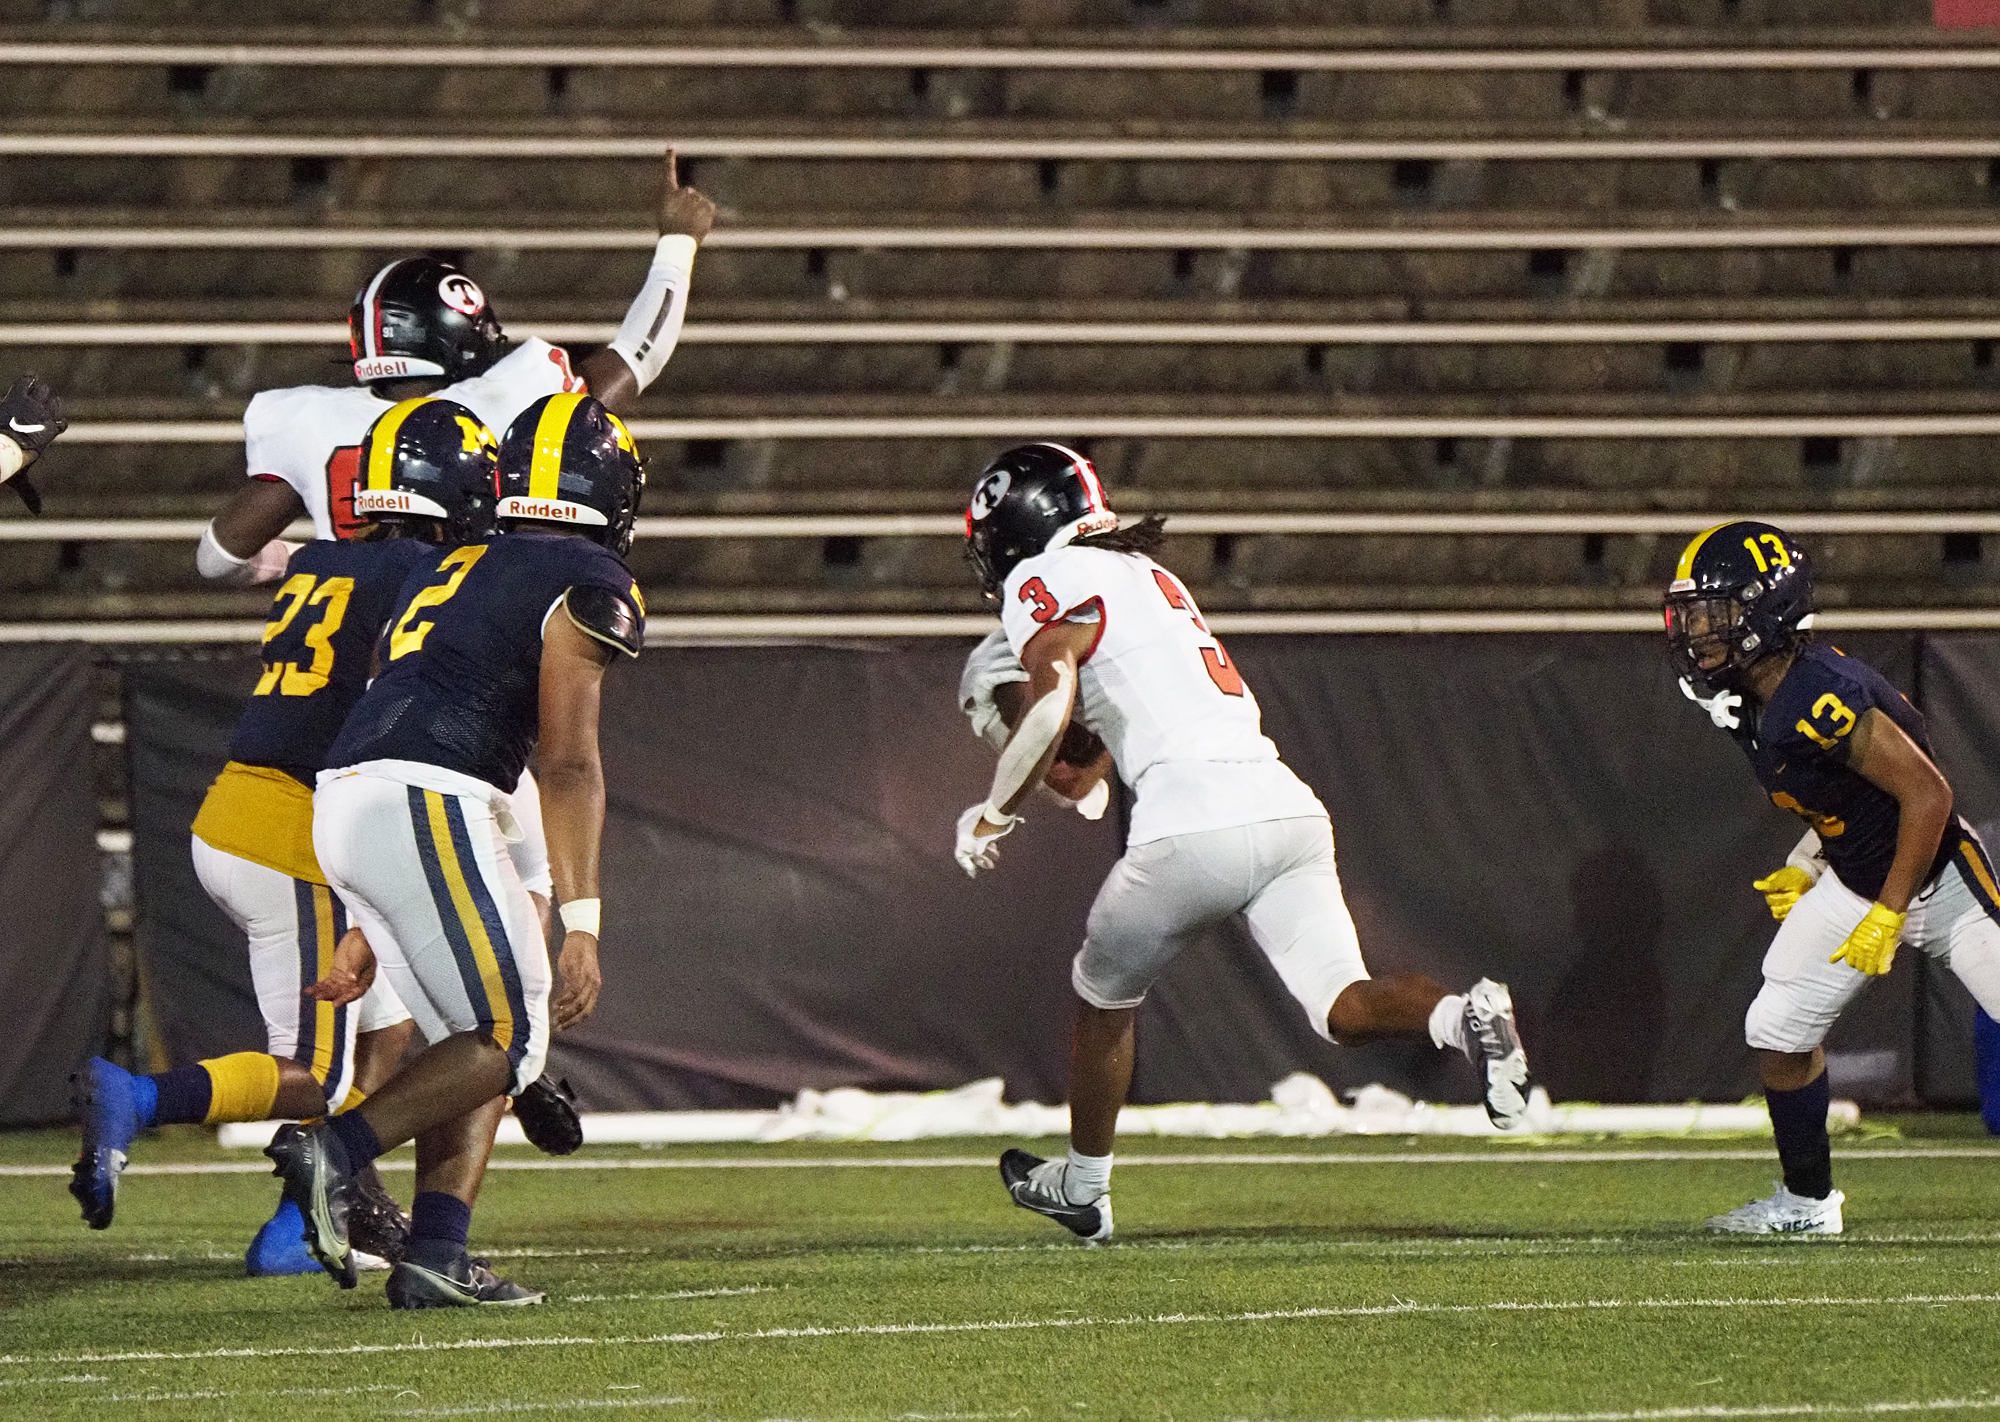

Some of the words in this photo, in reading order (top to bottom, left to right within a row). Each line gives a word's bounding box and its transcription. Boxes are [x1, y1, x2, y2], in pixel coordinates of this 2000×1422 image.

[382, 326, 394, 338] 91
[453, 415, 498, 462] M
[358, 495, 410, 510] Riddell
[510, 501, 577, 520] Riddell
[975, 474, 1001, 510] T
[1743, 533, 1791, 573] 13
[389, 544, 489, 661] 2
[1018, 576, 1060, 624] 3
[253, 573, 355, 697] 23
[1151, 569, 1244, 698] 3
[1795, 692, 1857, 750] 13
